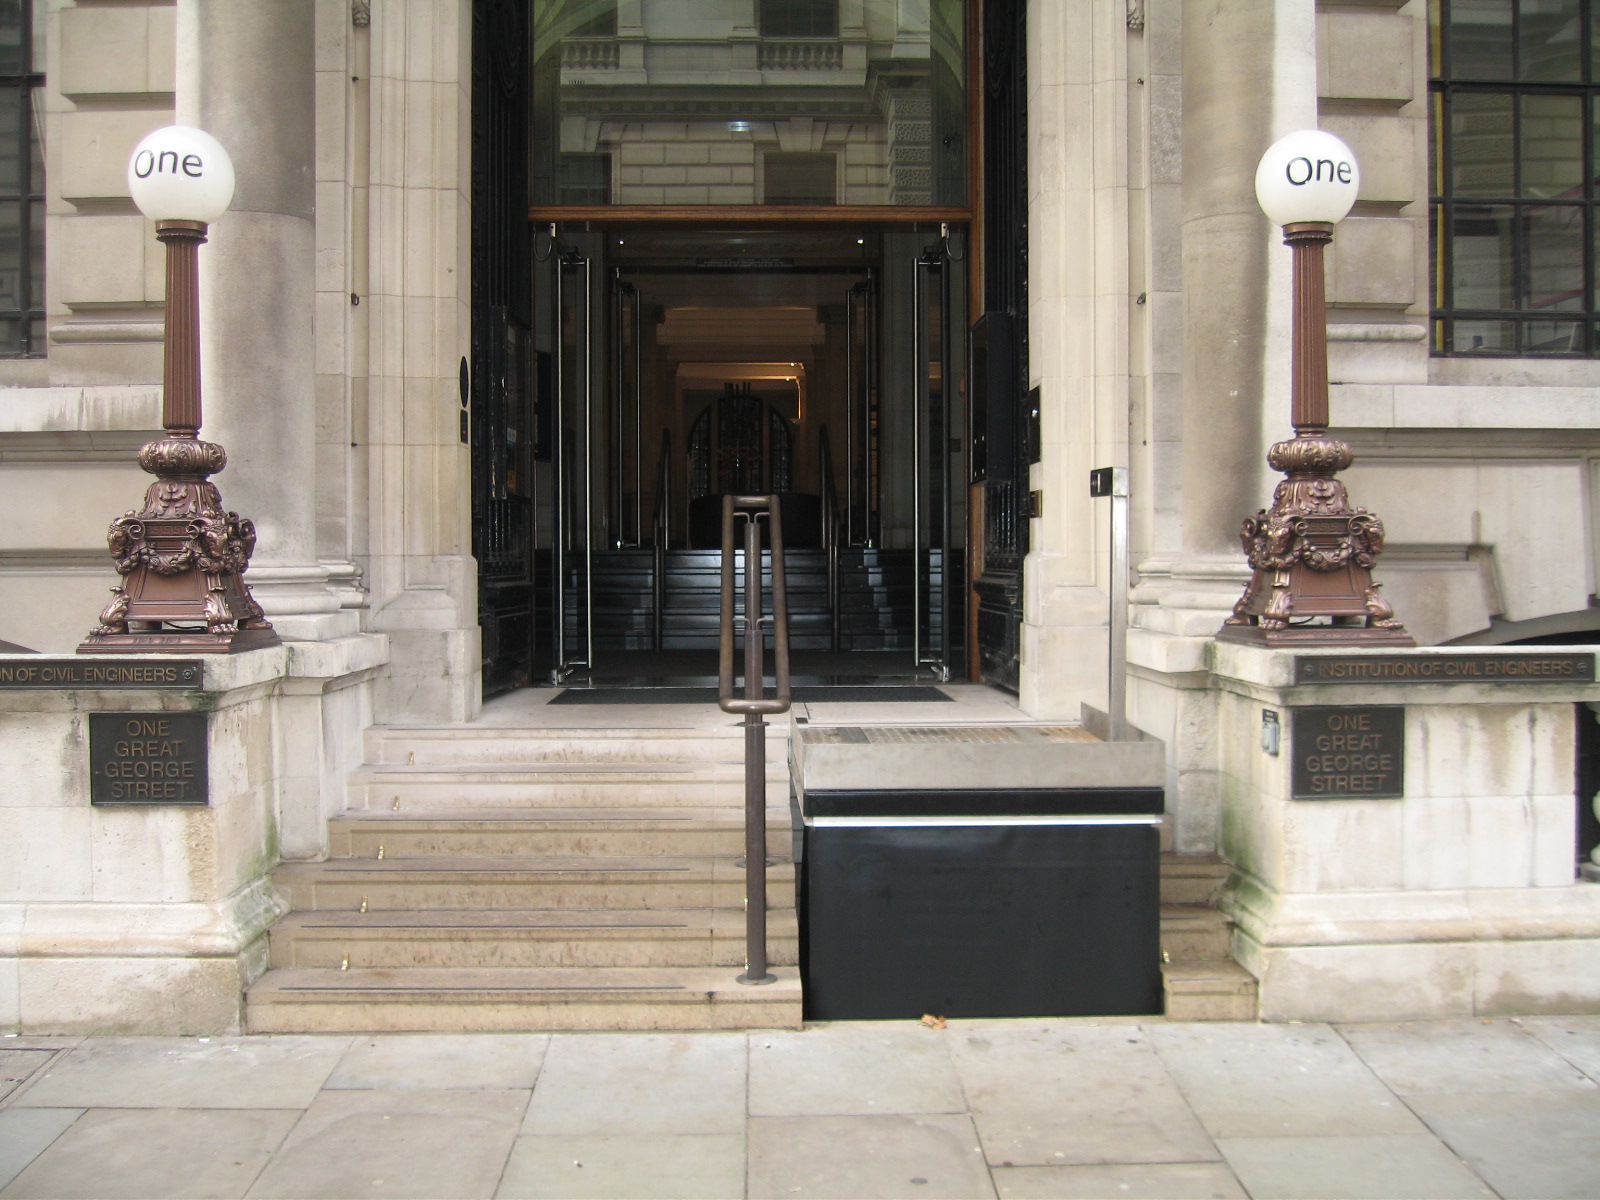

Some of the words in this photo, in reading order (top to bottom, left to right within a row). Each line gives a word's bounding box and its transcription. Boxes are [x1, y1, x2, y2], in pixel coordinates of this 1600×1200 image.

[135, 149, 203, 179] One
[1286, 156, 1352, 186] One
[17, 668, 38, 682] OF
[42, 667, 80, 682] CIVIL
[84, 667, 177, 682] ENGINEERS
[1319, 663, 1418, 677] INSTITUTION
[1420, 662, 1441, 676] OF
[1444, 661, 1481, 675] CIVIL
[1485, 660, 1573, 675] ENGINEERS
[126, 720, 170, 737] ONE
[1327, 714, 1371, 731] ONE
[114, 740, 183, 758] GREAT
[1316, 734, 1382, 751] GREAT
[104, 761, 194, 778] GEORGE
[1305, 754, 1393, 772] GEORGE
[111, 781, 189, 799] STREET
[1311, 774, 1386, 792] STREET
